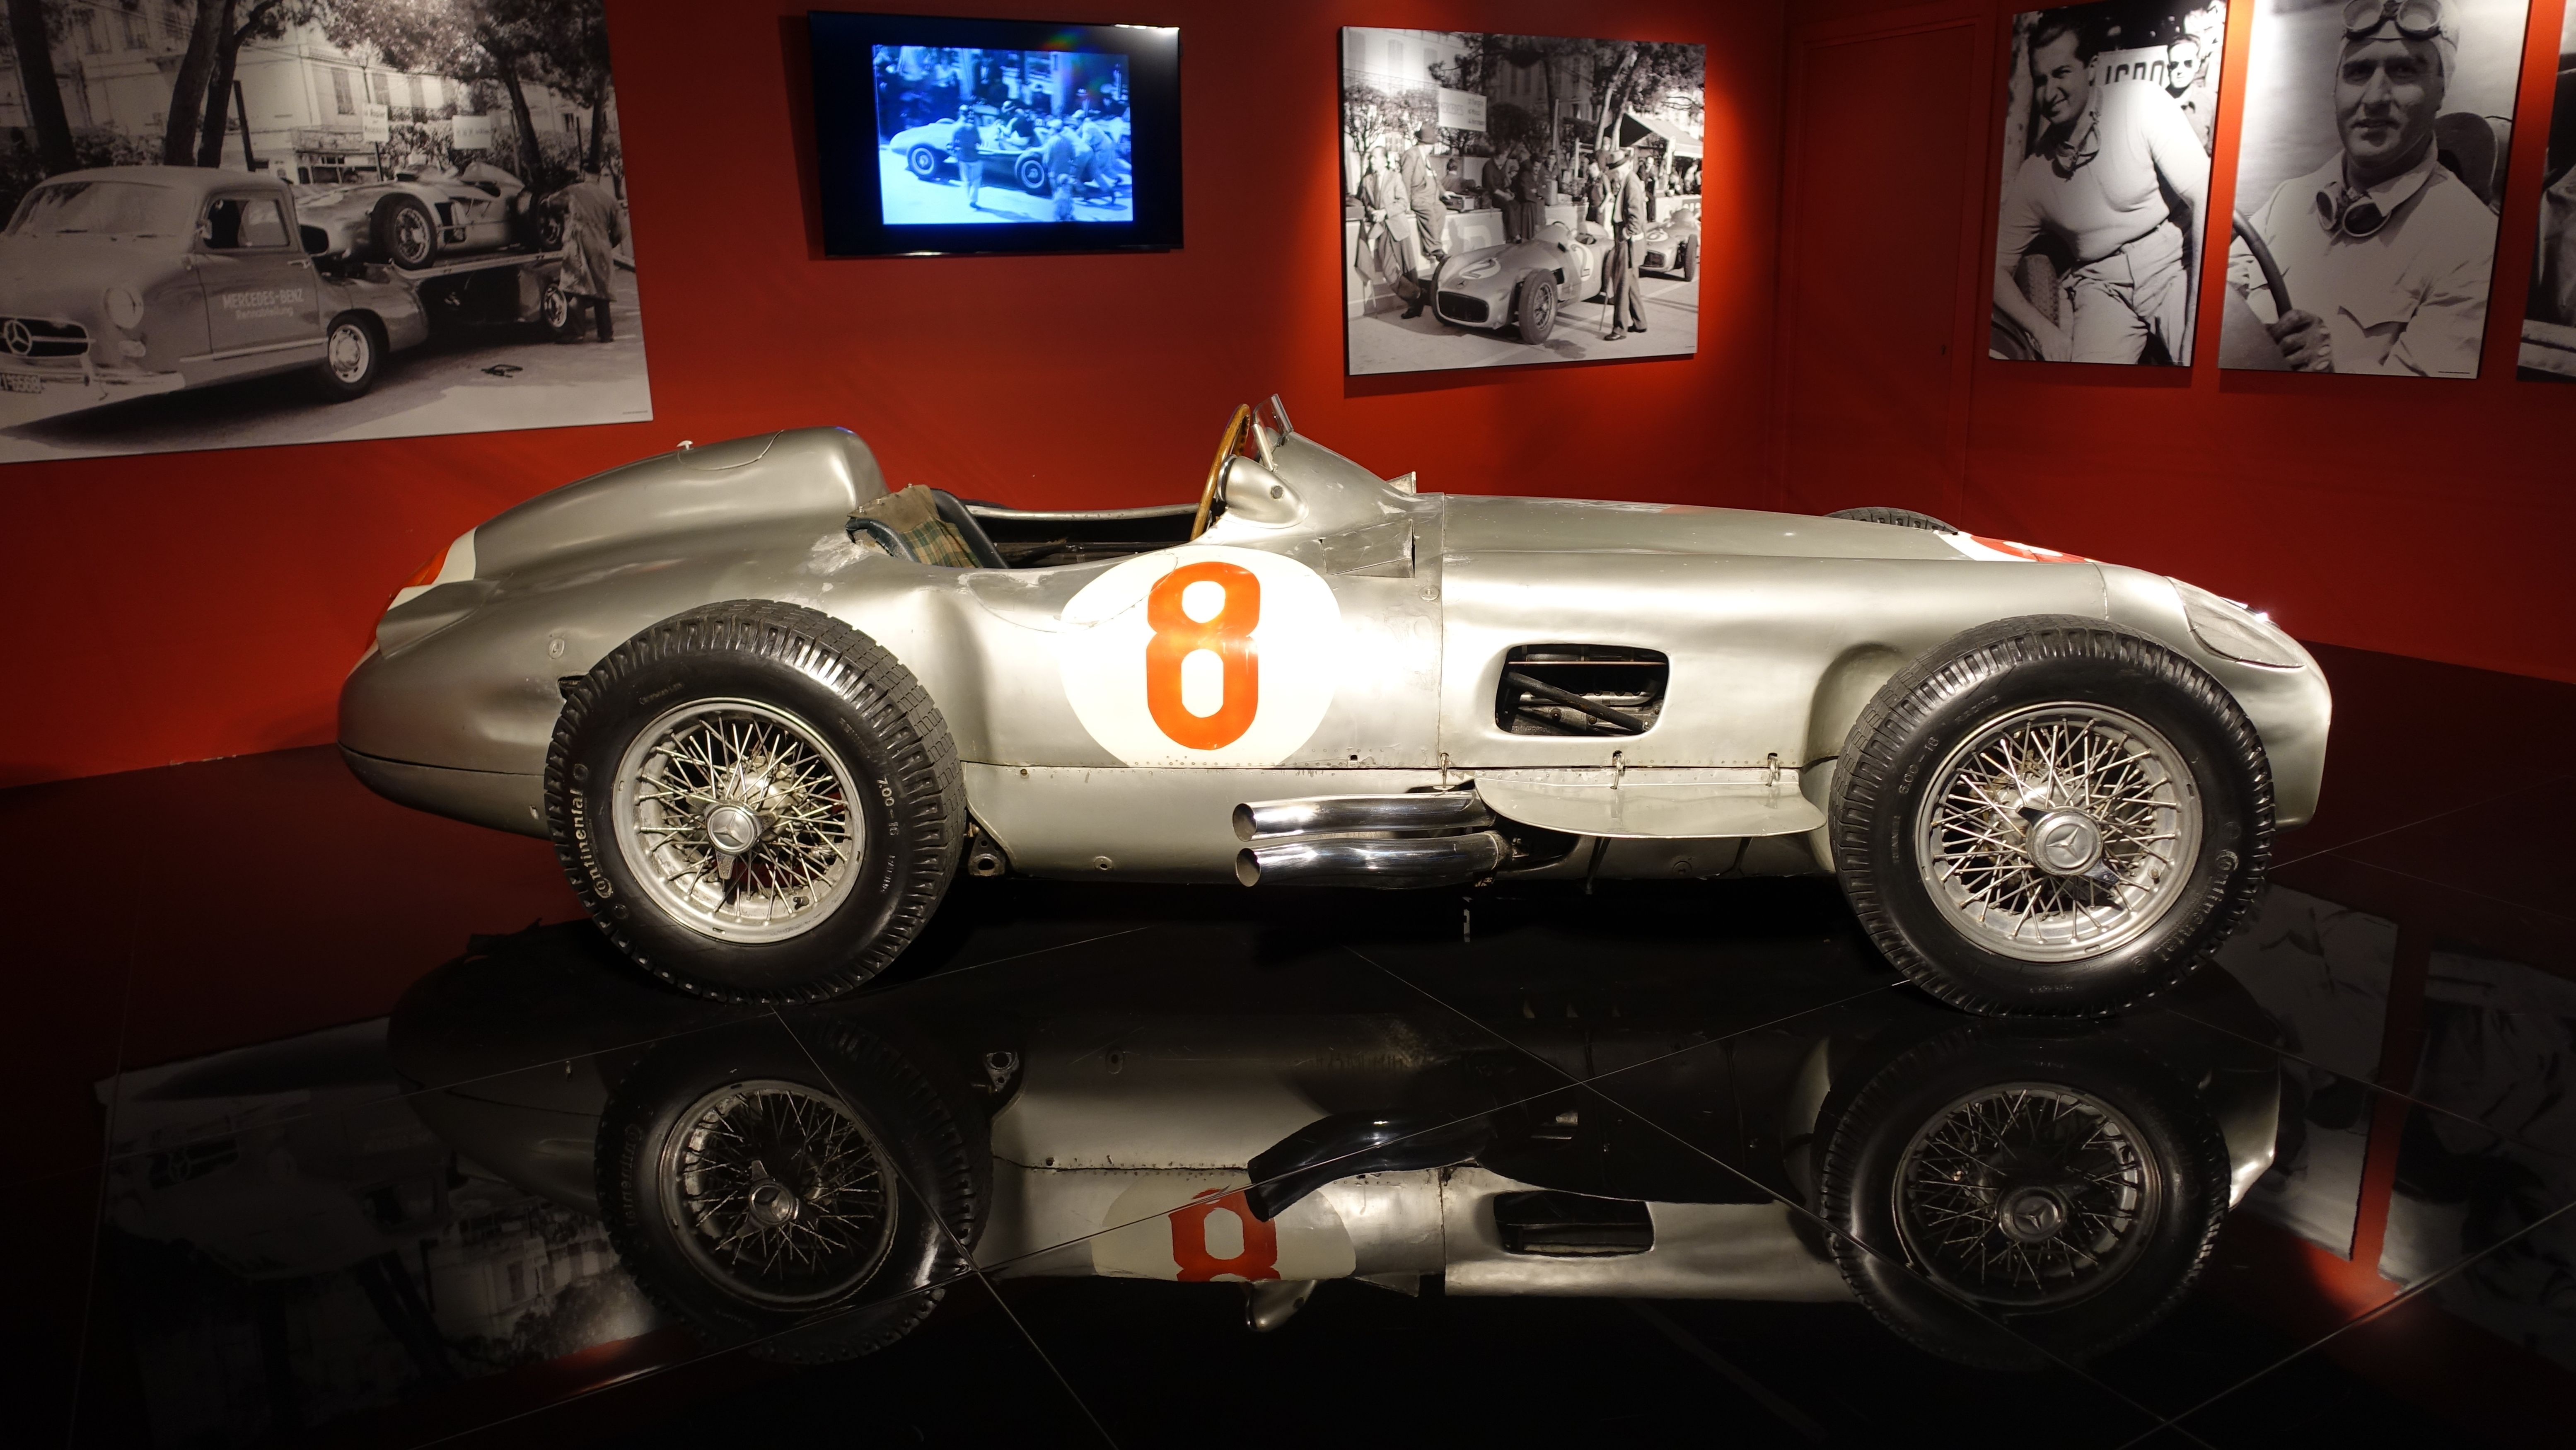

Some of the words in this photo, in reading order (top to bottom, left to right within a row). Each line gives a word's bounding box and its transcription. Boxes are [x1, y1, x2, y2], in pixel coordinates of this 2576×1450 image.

[1461, 258, 1497, 278] 2
[1571, 244, 1590, 277] 2
[222, 288, 304, 309] MERCEDES-BENZ
[1146, 561, 1260, 750] 8
[570, 788, 613, 899] Continental
